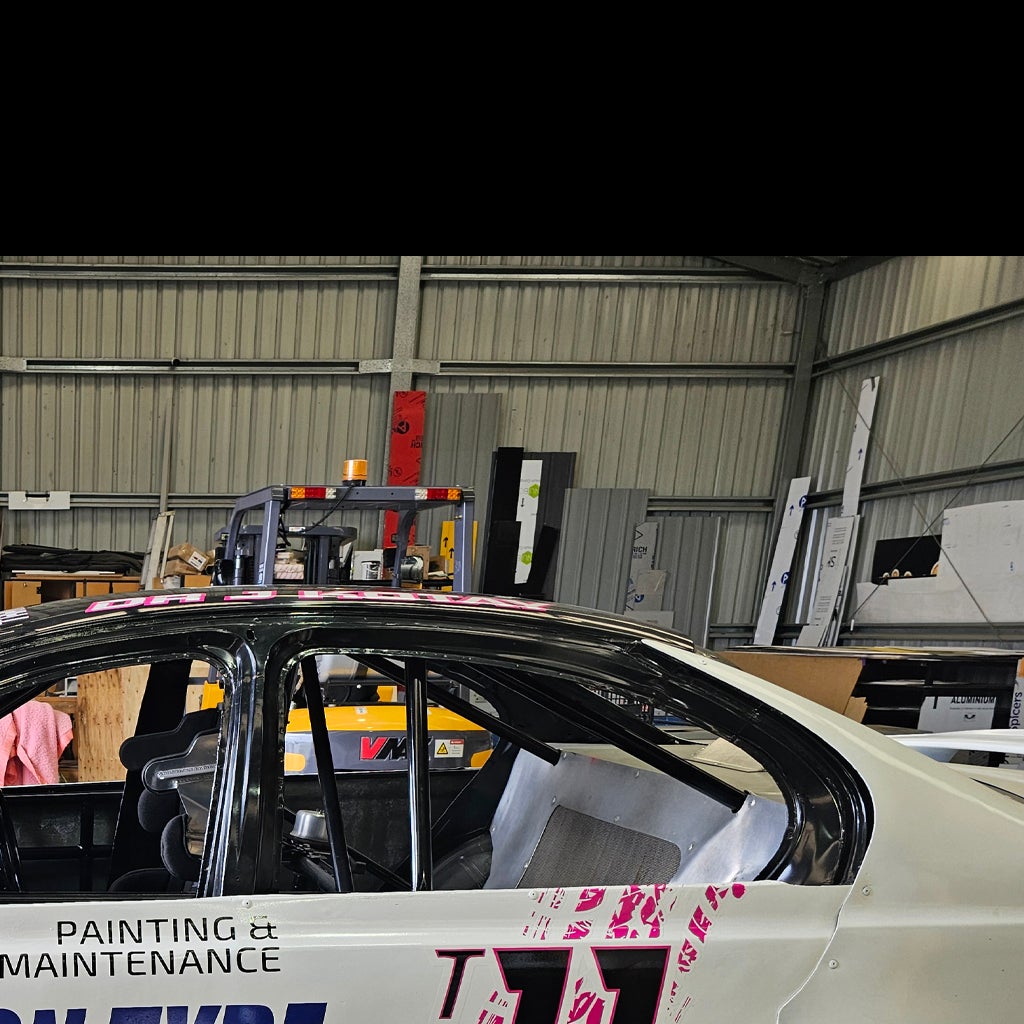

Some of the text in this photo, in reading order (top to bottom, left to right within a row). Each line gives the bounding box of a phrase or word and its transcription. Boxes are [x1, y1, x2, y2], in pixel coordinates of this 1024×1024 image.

[57, 915, 279, 945] PAINTING &
[0, 947, 281, 979] MAINTENANCE
[435, 949, 486, 1020] T
